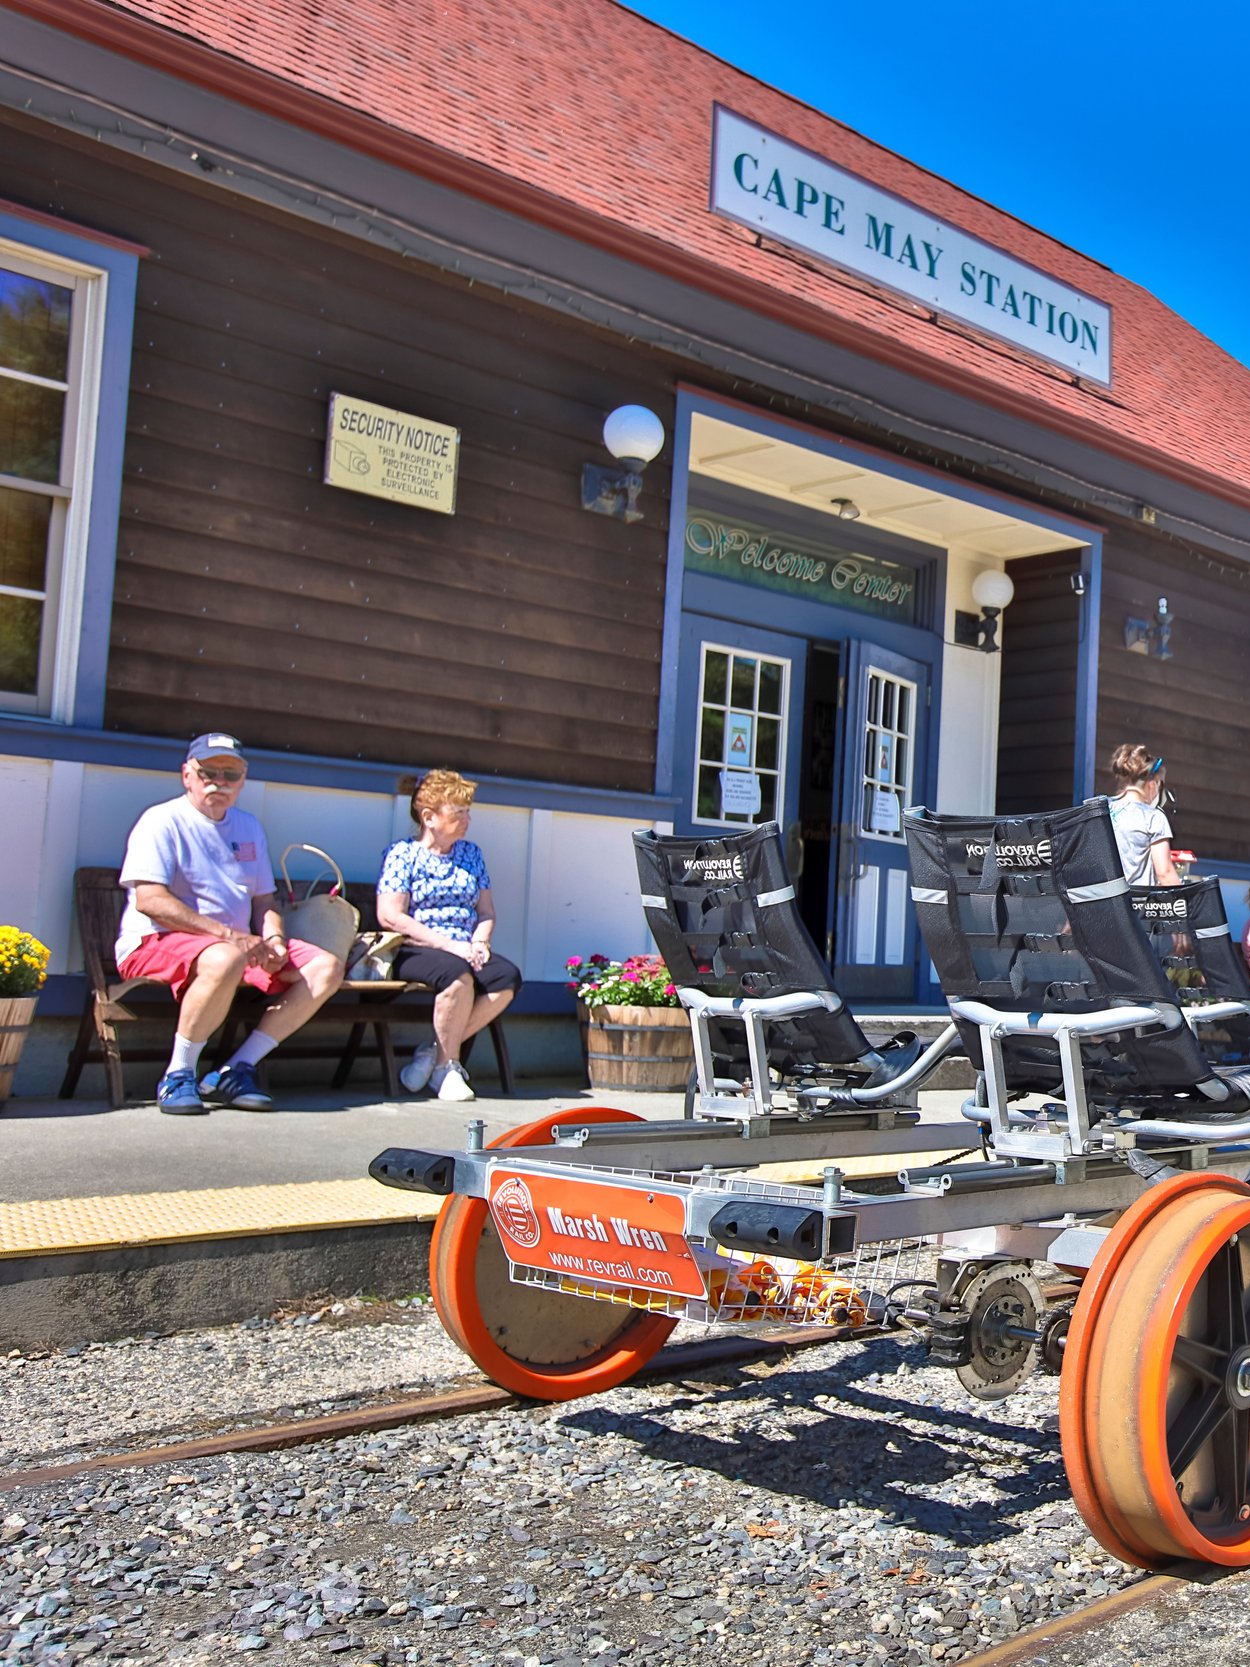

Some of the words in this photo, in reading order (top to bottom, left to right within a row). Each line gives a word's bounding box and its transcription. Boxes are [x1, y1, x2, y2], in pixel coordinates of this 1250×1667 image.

[733, 153, 846, 235] CAPE
[865, 212, 944, 280] MAY
[960, 261, 1100, 355] STATION
[340, 408, 405, 444] SECURITY
[405, 427, 451, 457] NOTICE
[378, 445, 395, 458] THIS
[400, 451, 442, 470] PROPERTY
[383, 457, 429, 477] PROTECTED
[433, 470, 444, 481] BY
[381, 477, 440, 500] SURVEILLANCE
[387, 468, 435, 488] ELECTRONIC
[685, 518, 826, 583] Welcome
[831, 559, 912, 604] Center
[546, 1206, 609, 1242] Marsh
[610, 1217, 668, 1252] Wren
[548, 1252, 674, 1286] www.revrail.com
